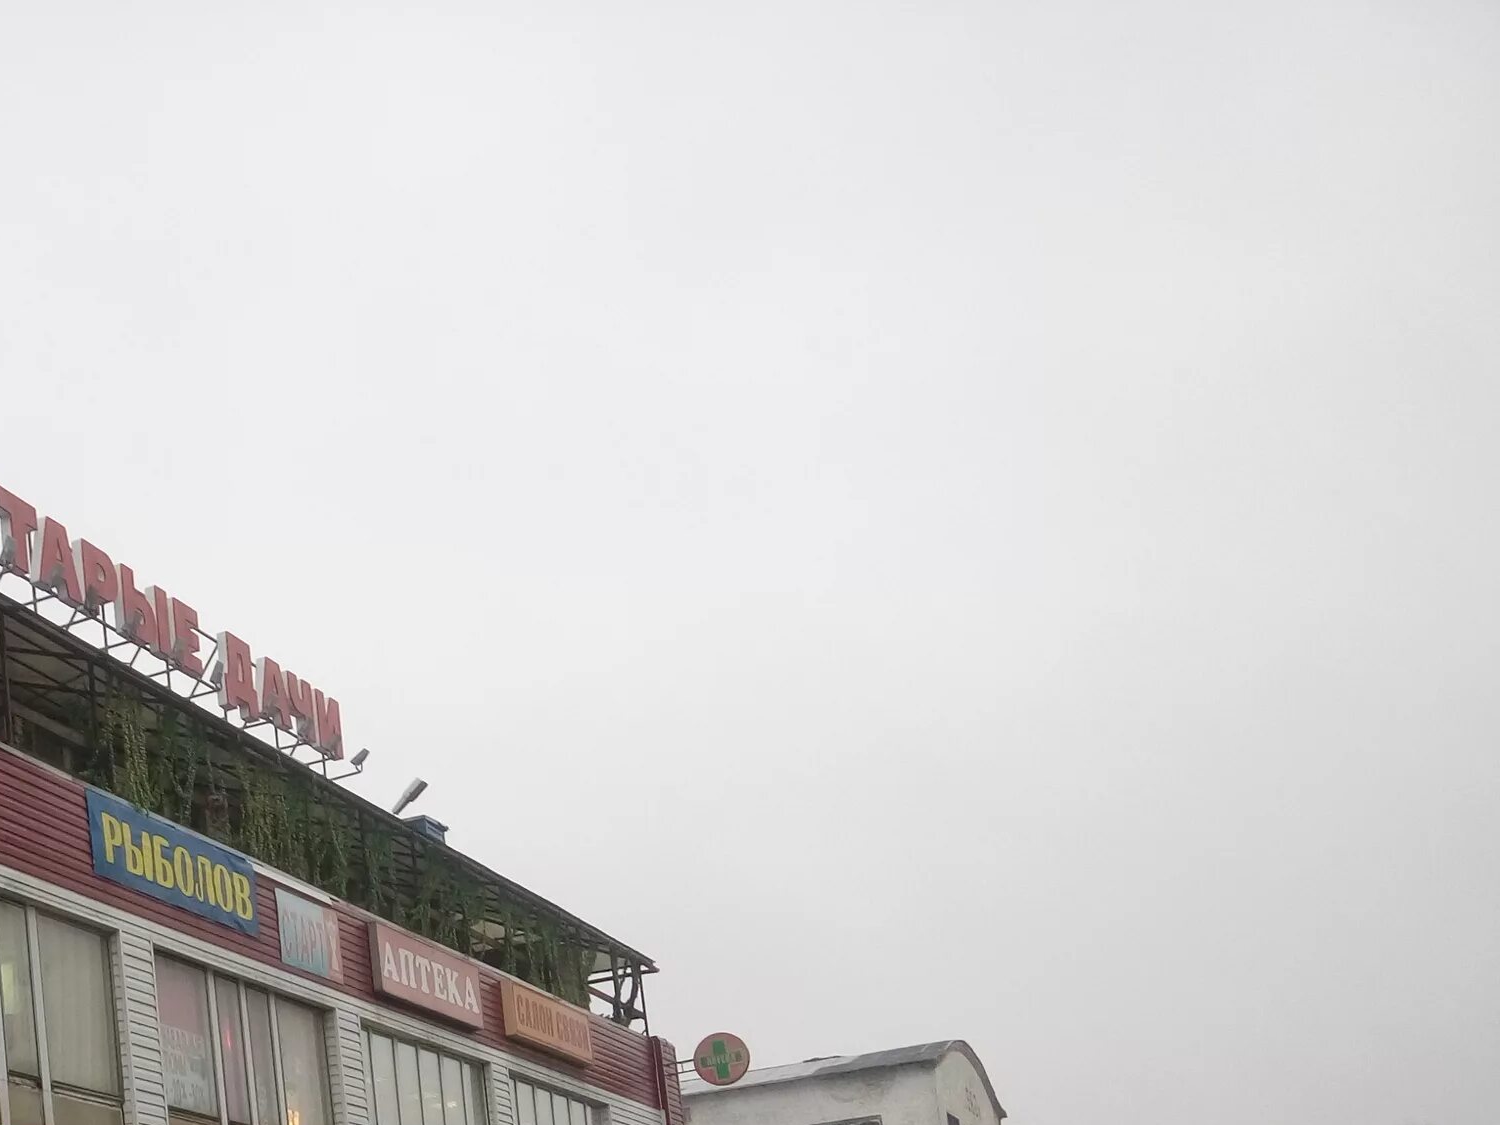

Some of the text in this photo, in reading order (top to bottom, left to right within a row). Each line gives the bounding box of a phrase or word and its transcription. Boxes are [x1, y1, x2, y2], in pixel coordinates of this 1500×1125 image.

[217, 630, 345, 760] ДАЧИ
[101, 811, 254, 922] РЫБОЛОВ
[383, 941, 480, 1015] АПТЕКА
